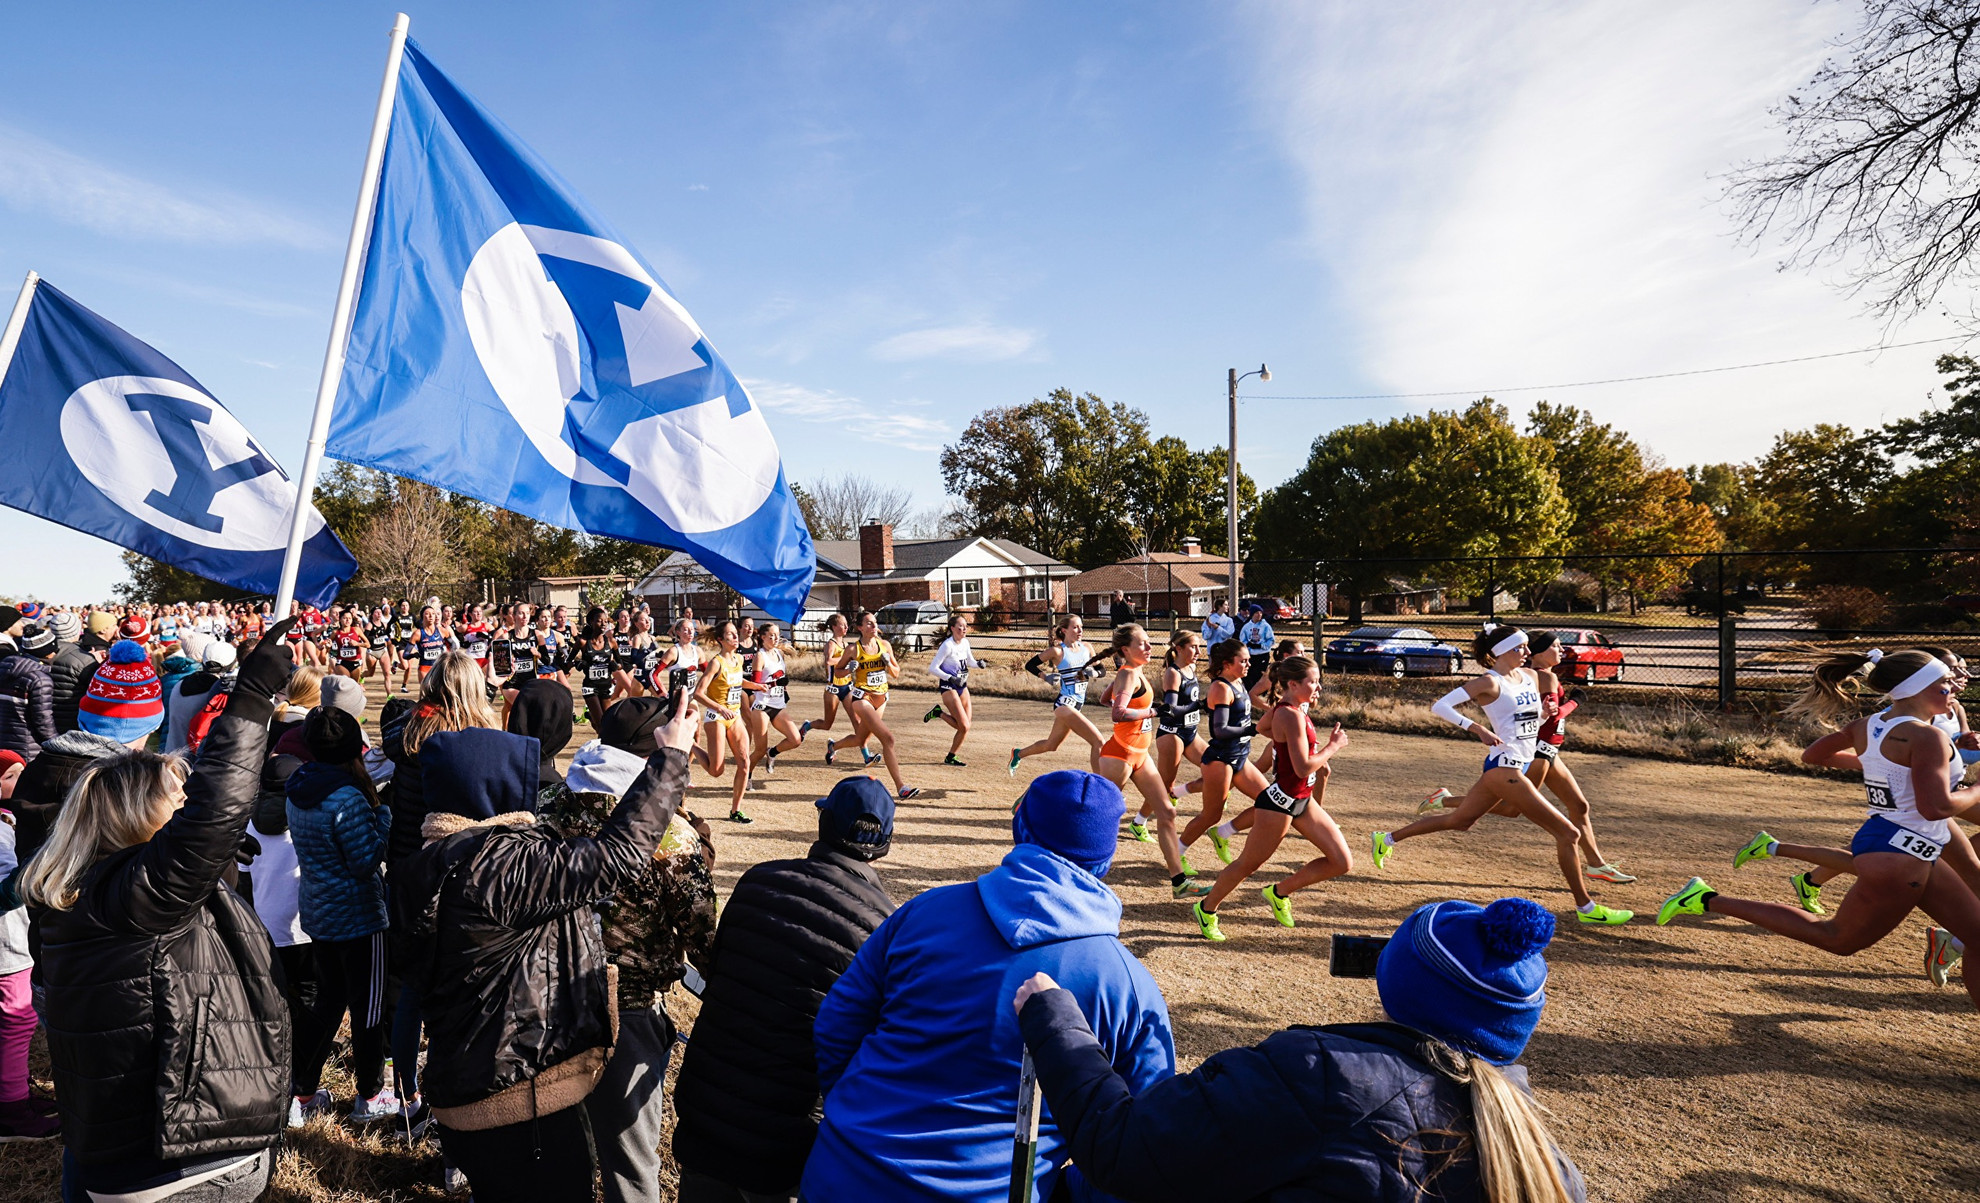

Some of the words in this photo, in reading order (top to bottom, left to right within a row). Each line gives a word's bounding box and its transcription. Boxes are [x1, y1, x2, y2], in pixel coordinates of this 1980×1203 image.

[537, 253, 752, 487] Y
[124, 393, 290, 534] Y
[512, 641, 536, 650] NAU
[517, 662, 531, 670] 285
[592, 669, 605, 677] 101
[870, 675, 884, 684] 492
[1515, 691, 1538, 705] BYU
[1520, 721, 1538, 733] 139
[1270, 786, 1287, 806] 369
[1866, 786, 1888, 806] 138
[1901, 835, 1937, 858] 138
